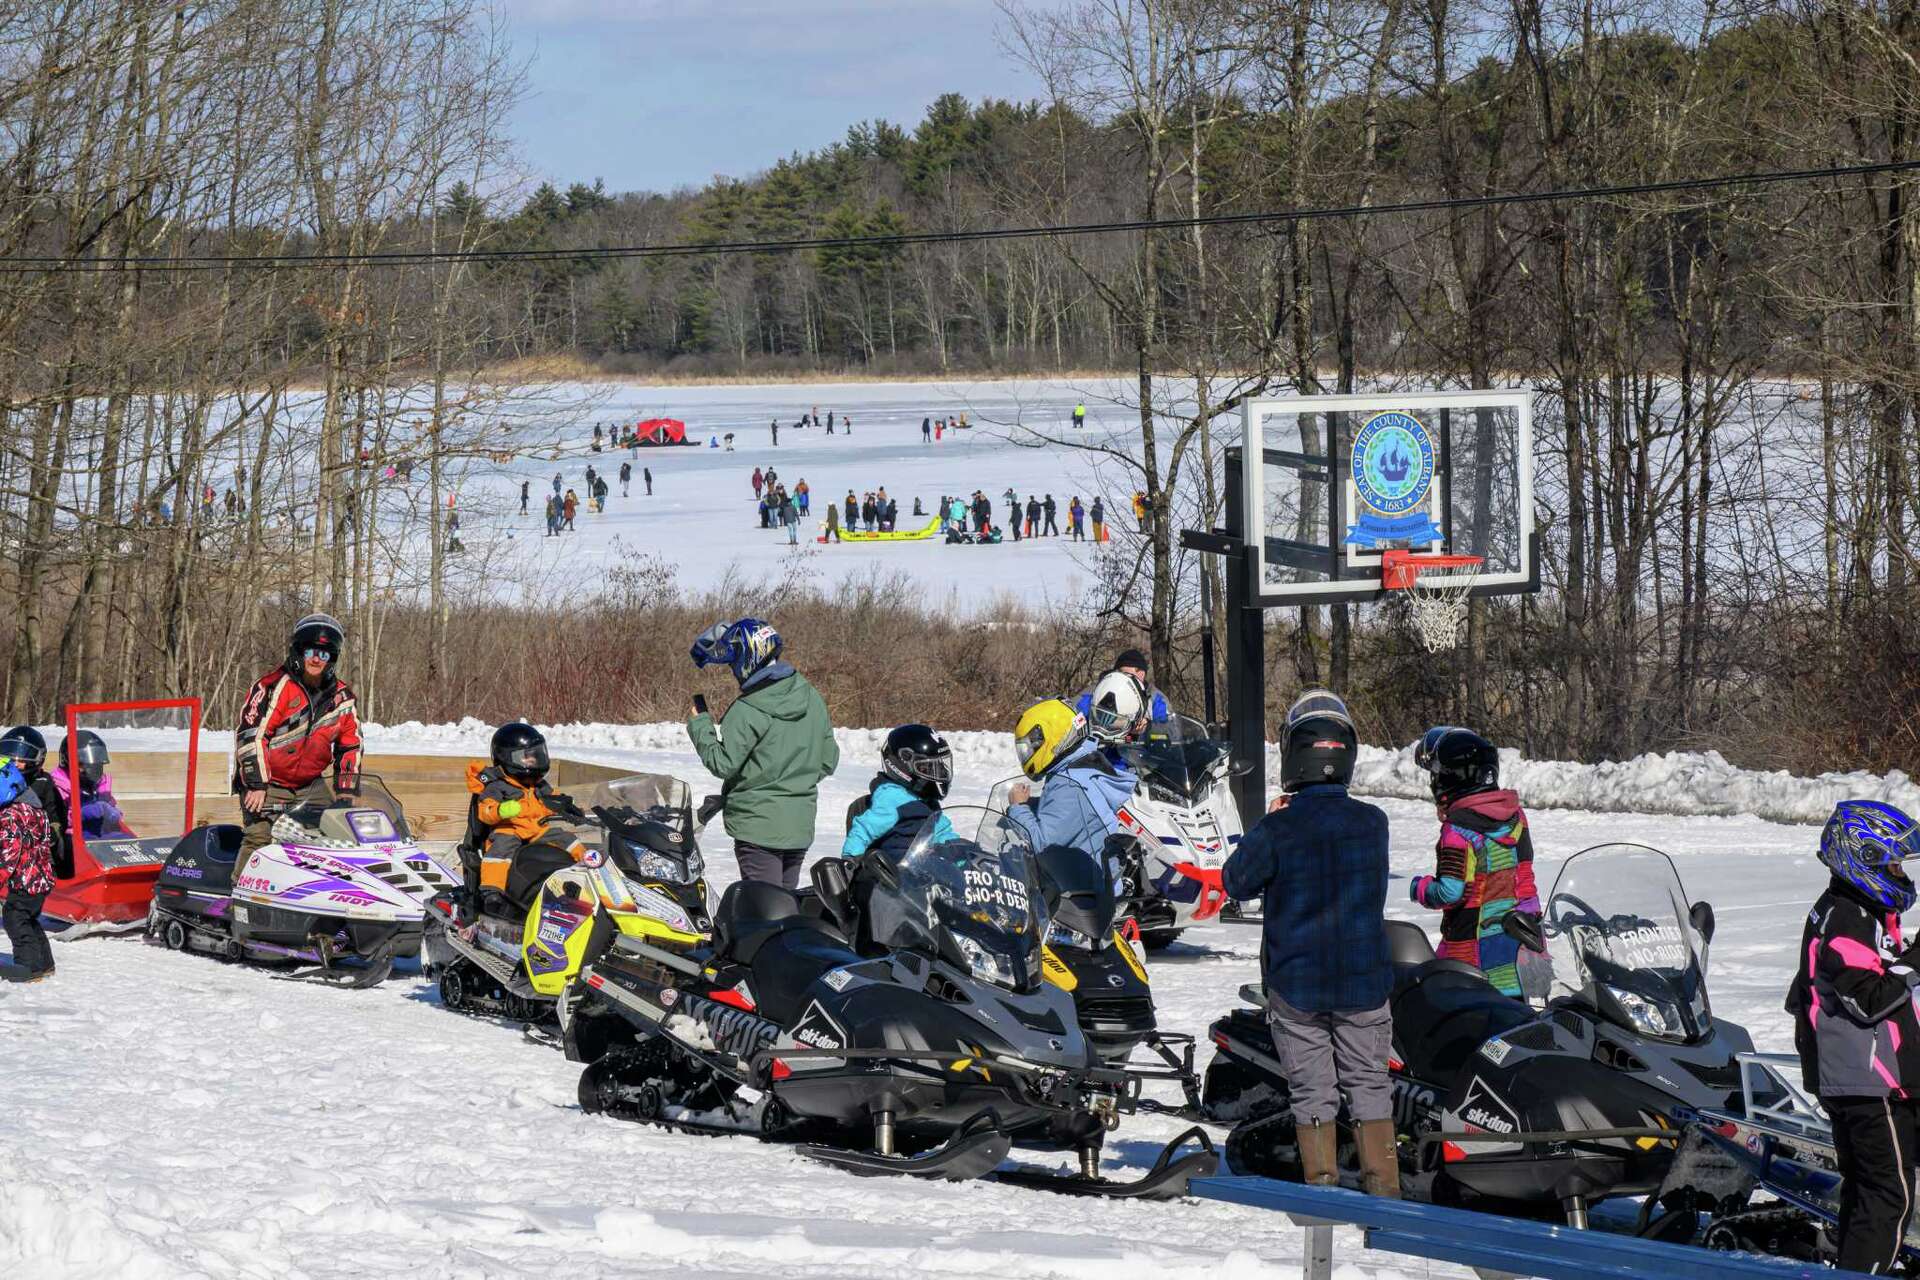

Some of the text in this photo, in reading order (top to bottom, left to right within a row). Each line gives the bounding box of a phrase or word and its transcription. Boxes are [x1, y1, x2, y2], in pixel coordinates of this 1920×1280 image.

[1353, 414, 1433, 501] SEAL OF THE COUNTY OF ALBANY
[1384, 500, 1405, 511] 1683
[166, 865, 204, 879] POLARIS
[298, 850, 361, 874] SUPER SPORT
[964, 870, 1027, 897] FROTIER
[328, 894, 375, 906] INDY
[799, 1028, 840, 1049] ski-doo
[1466, 1107, 1514, 1134] ski-doo
